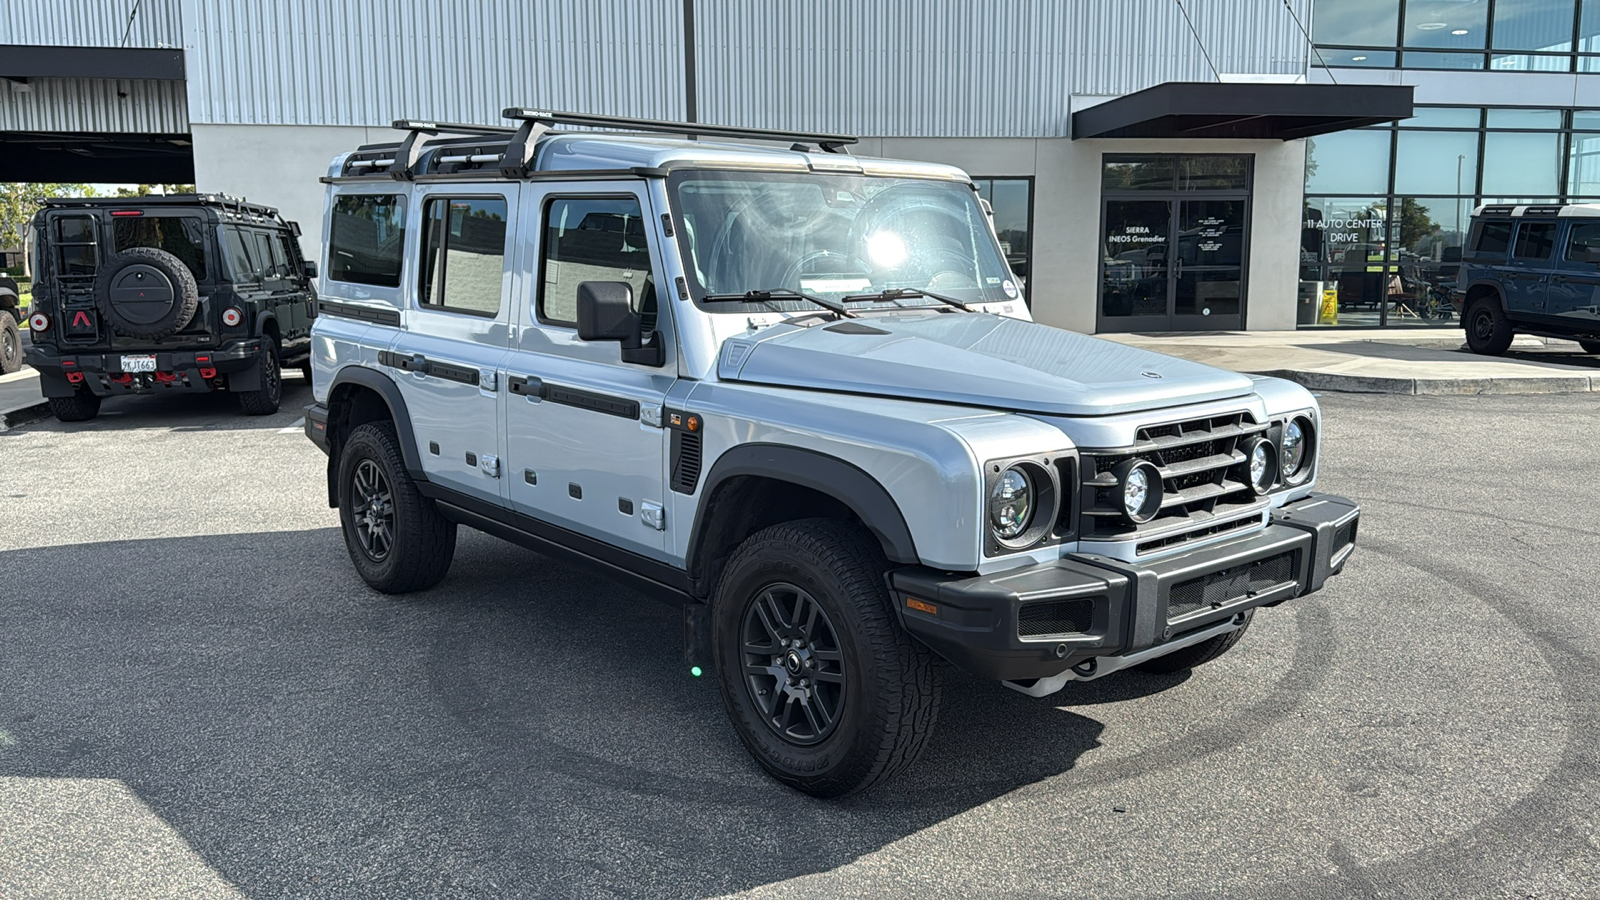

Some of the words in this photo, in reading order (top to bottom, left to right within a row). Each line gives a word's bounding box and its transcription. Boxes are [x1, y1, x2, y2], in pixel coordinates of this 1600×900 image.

[1307, 219, 1314, 229] 11
[1315, 219, 1344, 229] AUTO
[1345, 219, 1383, 229] CENTER
[1125, 226, 1150, 234] SIERRA
[1108, 235, 1131, 243] INEOS
[1131, 234, 1166, 243] Grenadier
[1330, 233, 1359, 242] DRIVE
